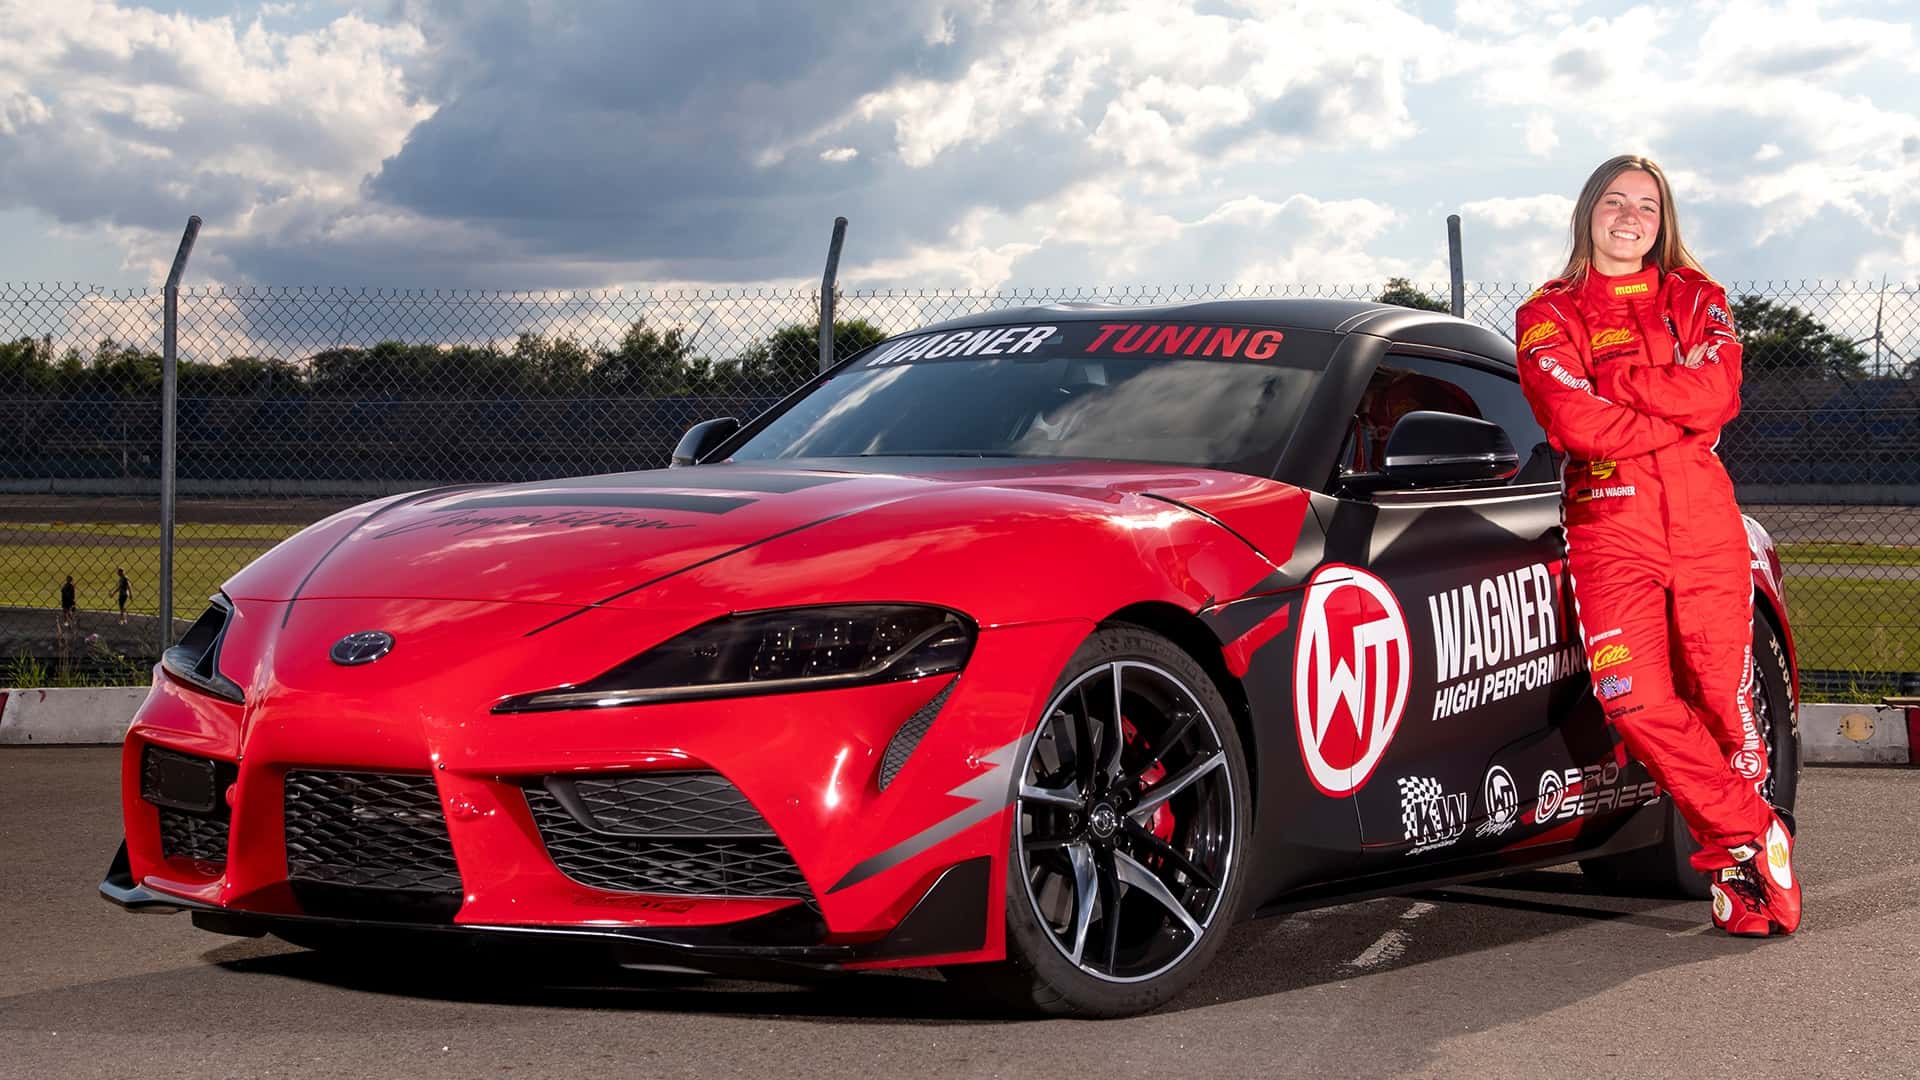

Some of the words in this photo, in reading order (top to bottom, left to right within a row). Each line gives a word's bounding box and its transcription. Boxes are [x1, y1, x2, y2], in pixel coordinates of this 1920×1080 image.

[865, 325, 1058, 368] WAGNER
[1085, 324, 1285, 360] TUNING
[1591, 487, 1605, 499] LEA
[1605, 486, 1636, 498] WAGNER
[1432, 679, 1480, 721] HIGH
[1564, 761, 1620, 791] PRO
[1556, 781, 1657, 819] SERIES
